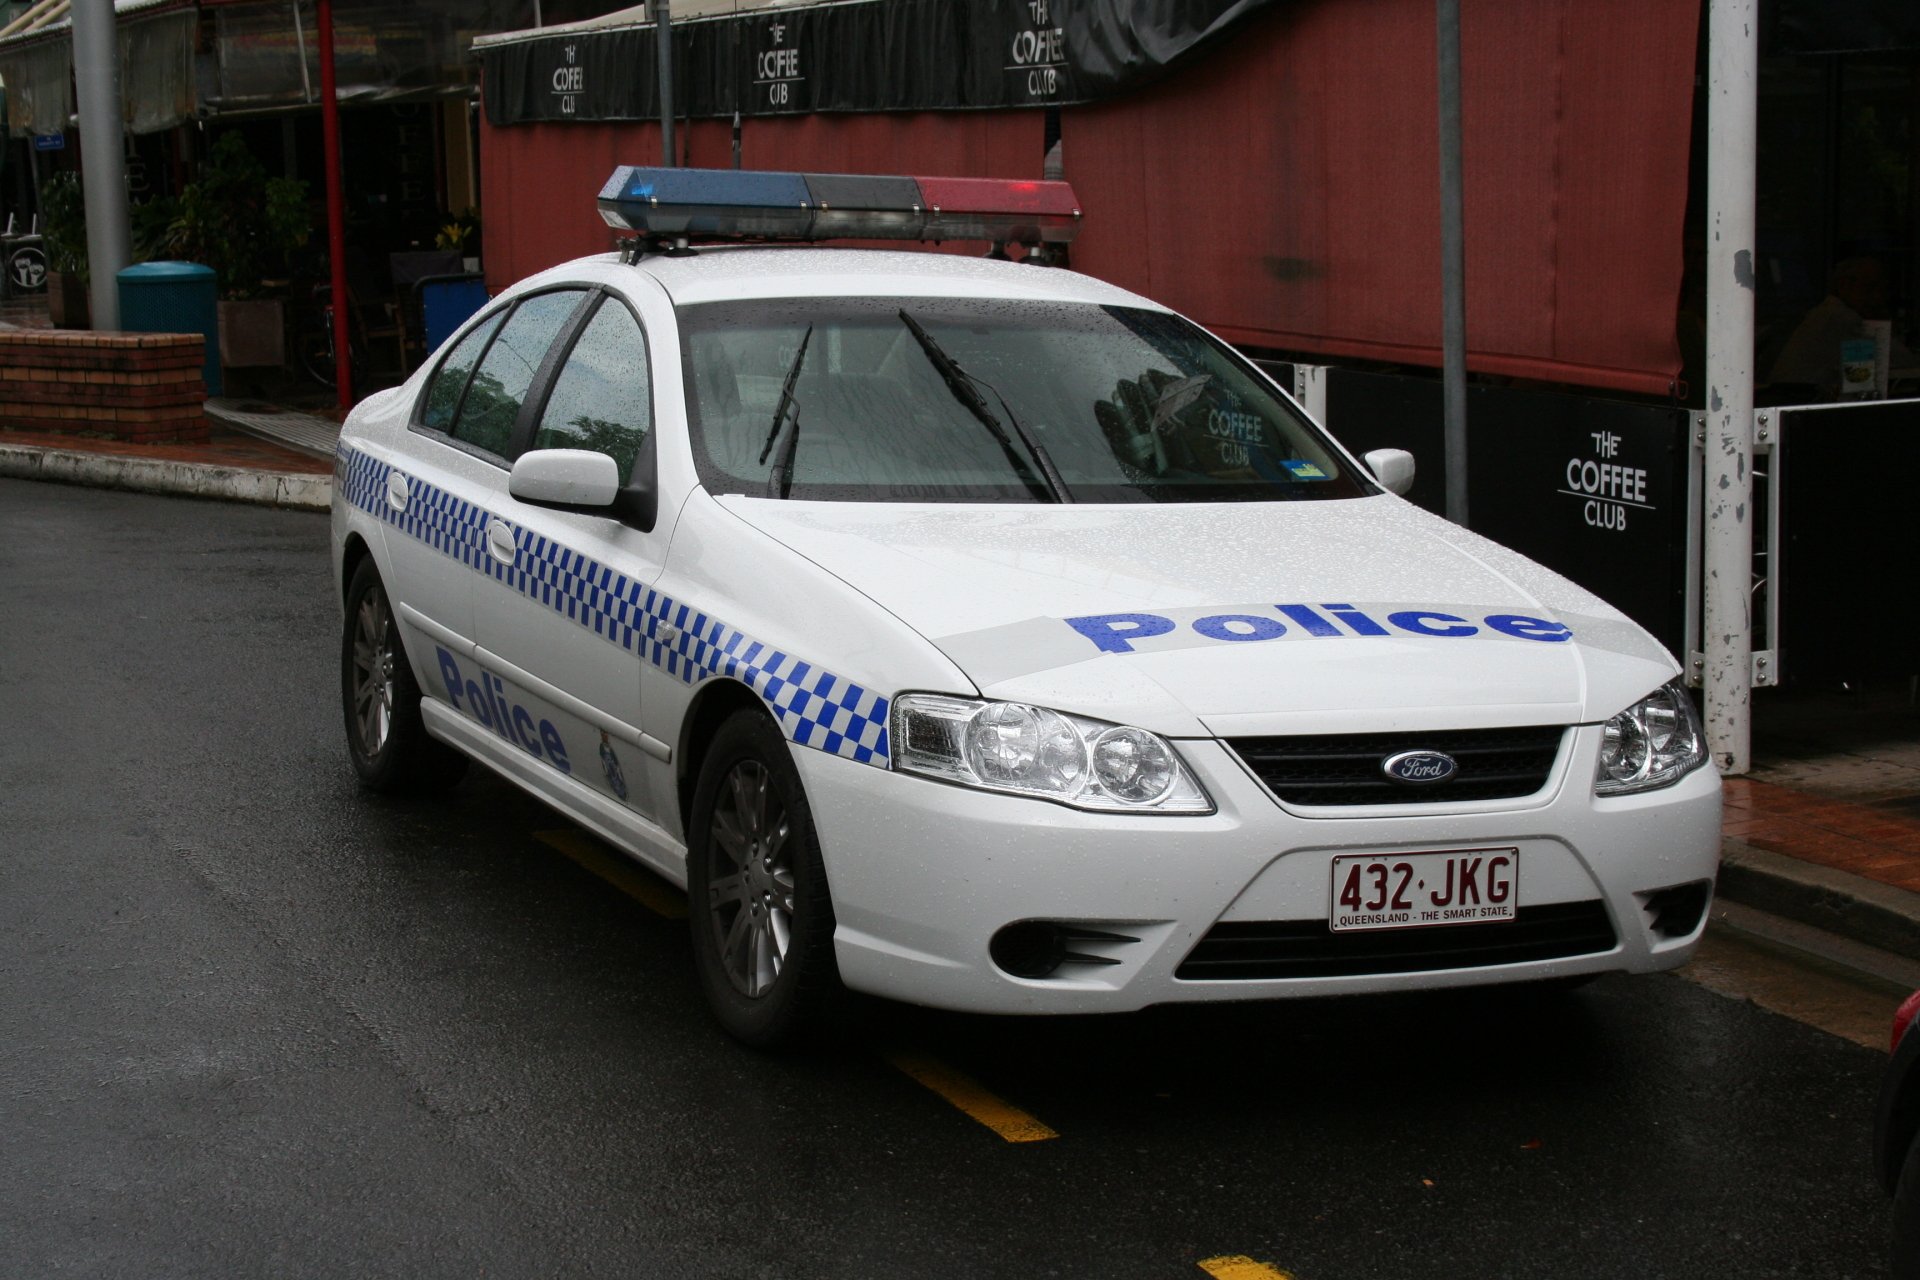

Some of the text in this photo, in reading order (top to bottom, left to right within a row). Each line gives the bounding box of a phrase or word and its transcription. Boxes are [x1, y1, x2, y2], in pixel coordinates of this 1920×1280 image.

[1208, 408, 1263, 442] COFFEE
[1221, 441, 1250, 467] CLUB
[1590, 430, 1622, 459] THE
[1566, 458, 1647, 503] COFFEE
[1584, 500, 1627, 531] CLUB
[1062, 603, 1573, 654] Police
[435, 644, 572, 776] Police
[1401, 756, 1443, 778] Ford
[1339, 912, 1409, 927] QUEENSLAND
[1420, 910, 1440, 922] THE
[1443, 908, 1477, 920] SMART
[1480, 906, 1508, 917] STATE
